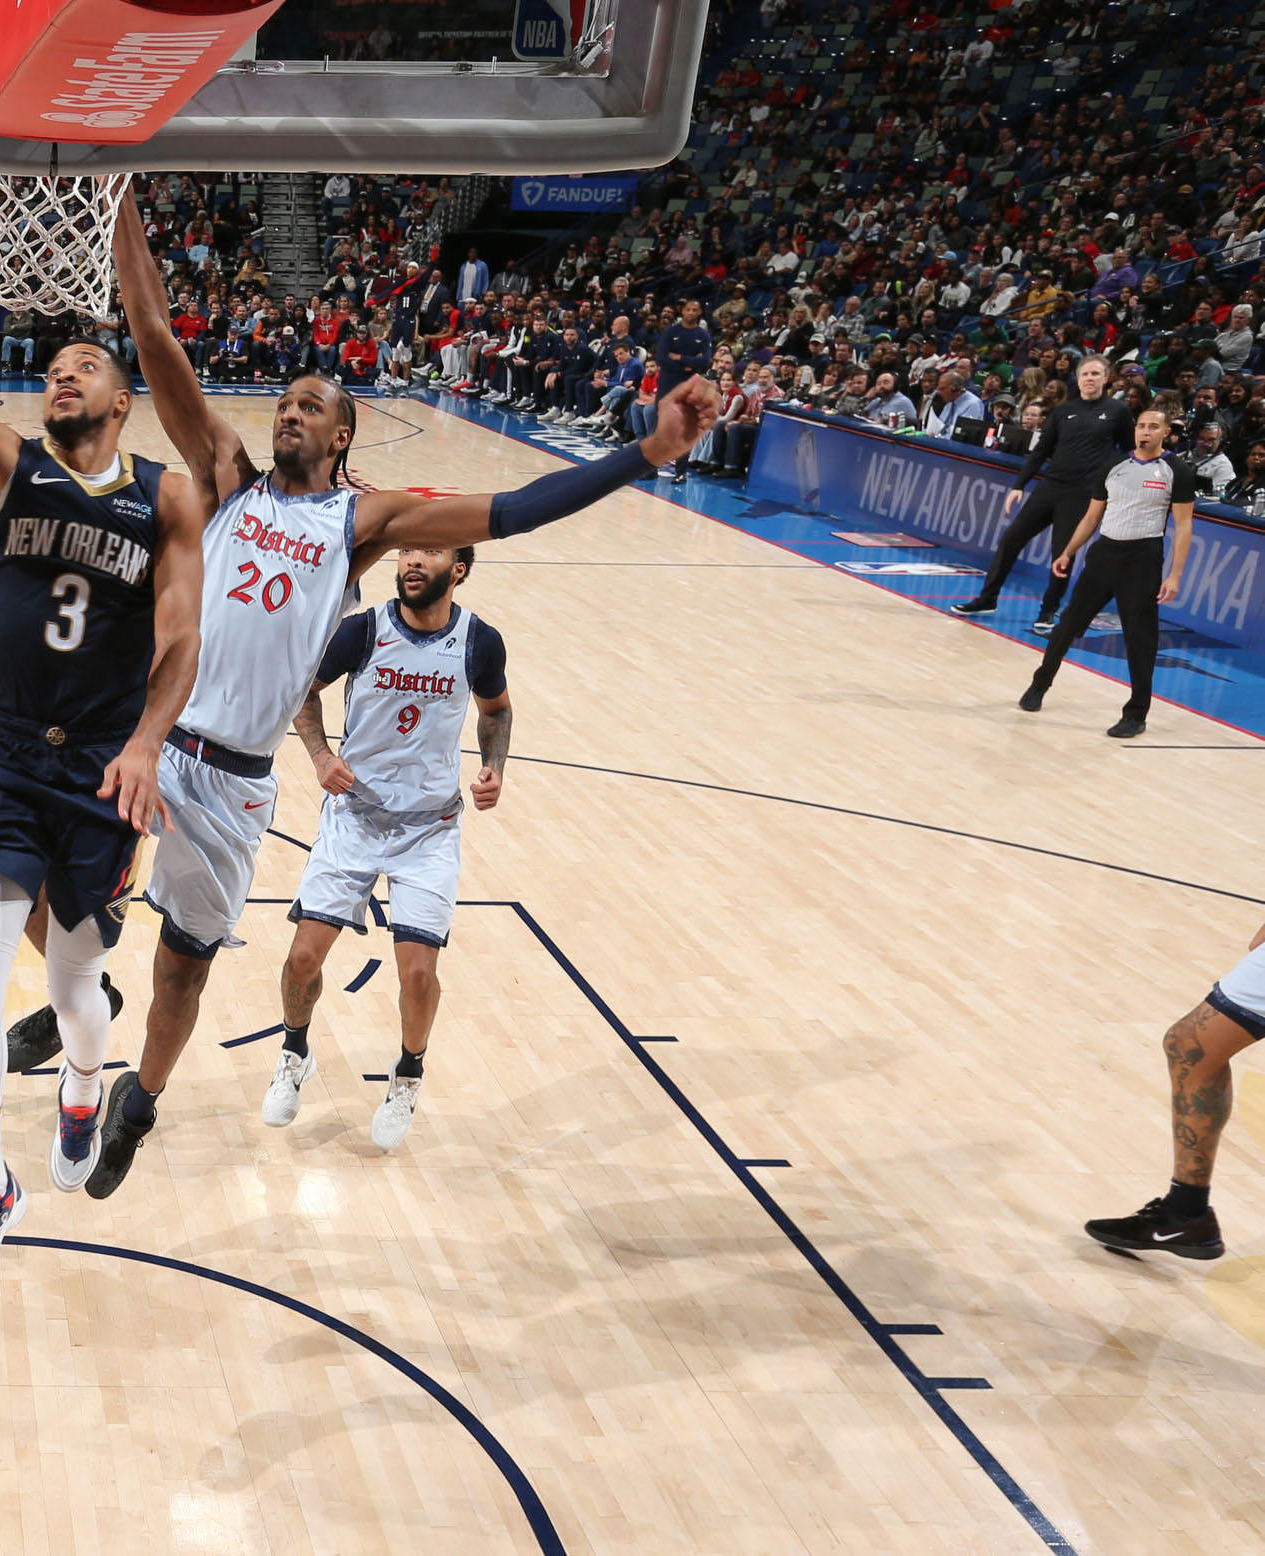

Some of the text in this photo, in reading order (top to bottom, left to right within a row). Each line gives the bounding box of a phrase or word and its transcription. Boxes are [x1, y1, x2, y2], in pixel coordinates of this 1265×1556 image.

[522, 20, 556, 48] NBA
[113, 498, 153, 515] NEWAGE
[116, 508, 147, 520] GARAGE
[4, 517, 61, 556] NEW
[231, 511, 326, 567] District
[859, 452, 925, 521] NEW
[1162, 526, 1260, 630] DKA
[227, 560, 294, 615] 20
[44, 572, 91, 652] 3
[373, 665, 456, 695] the District
[396, 703, 422, 737] 9
